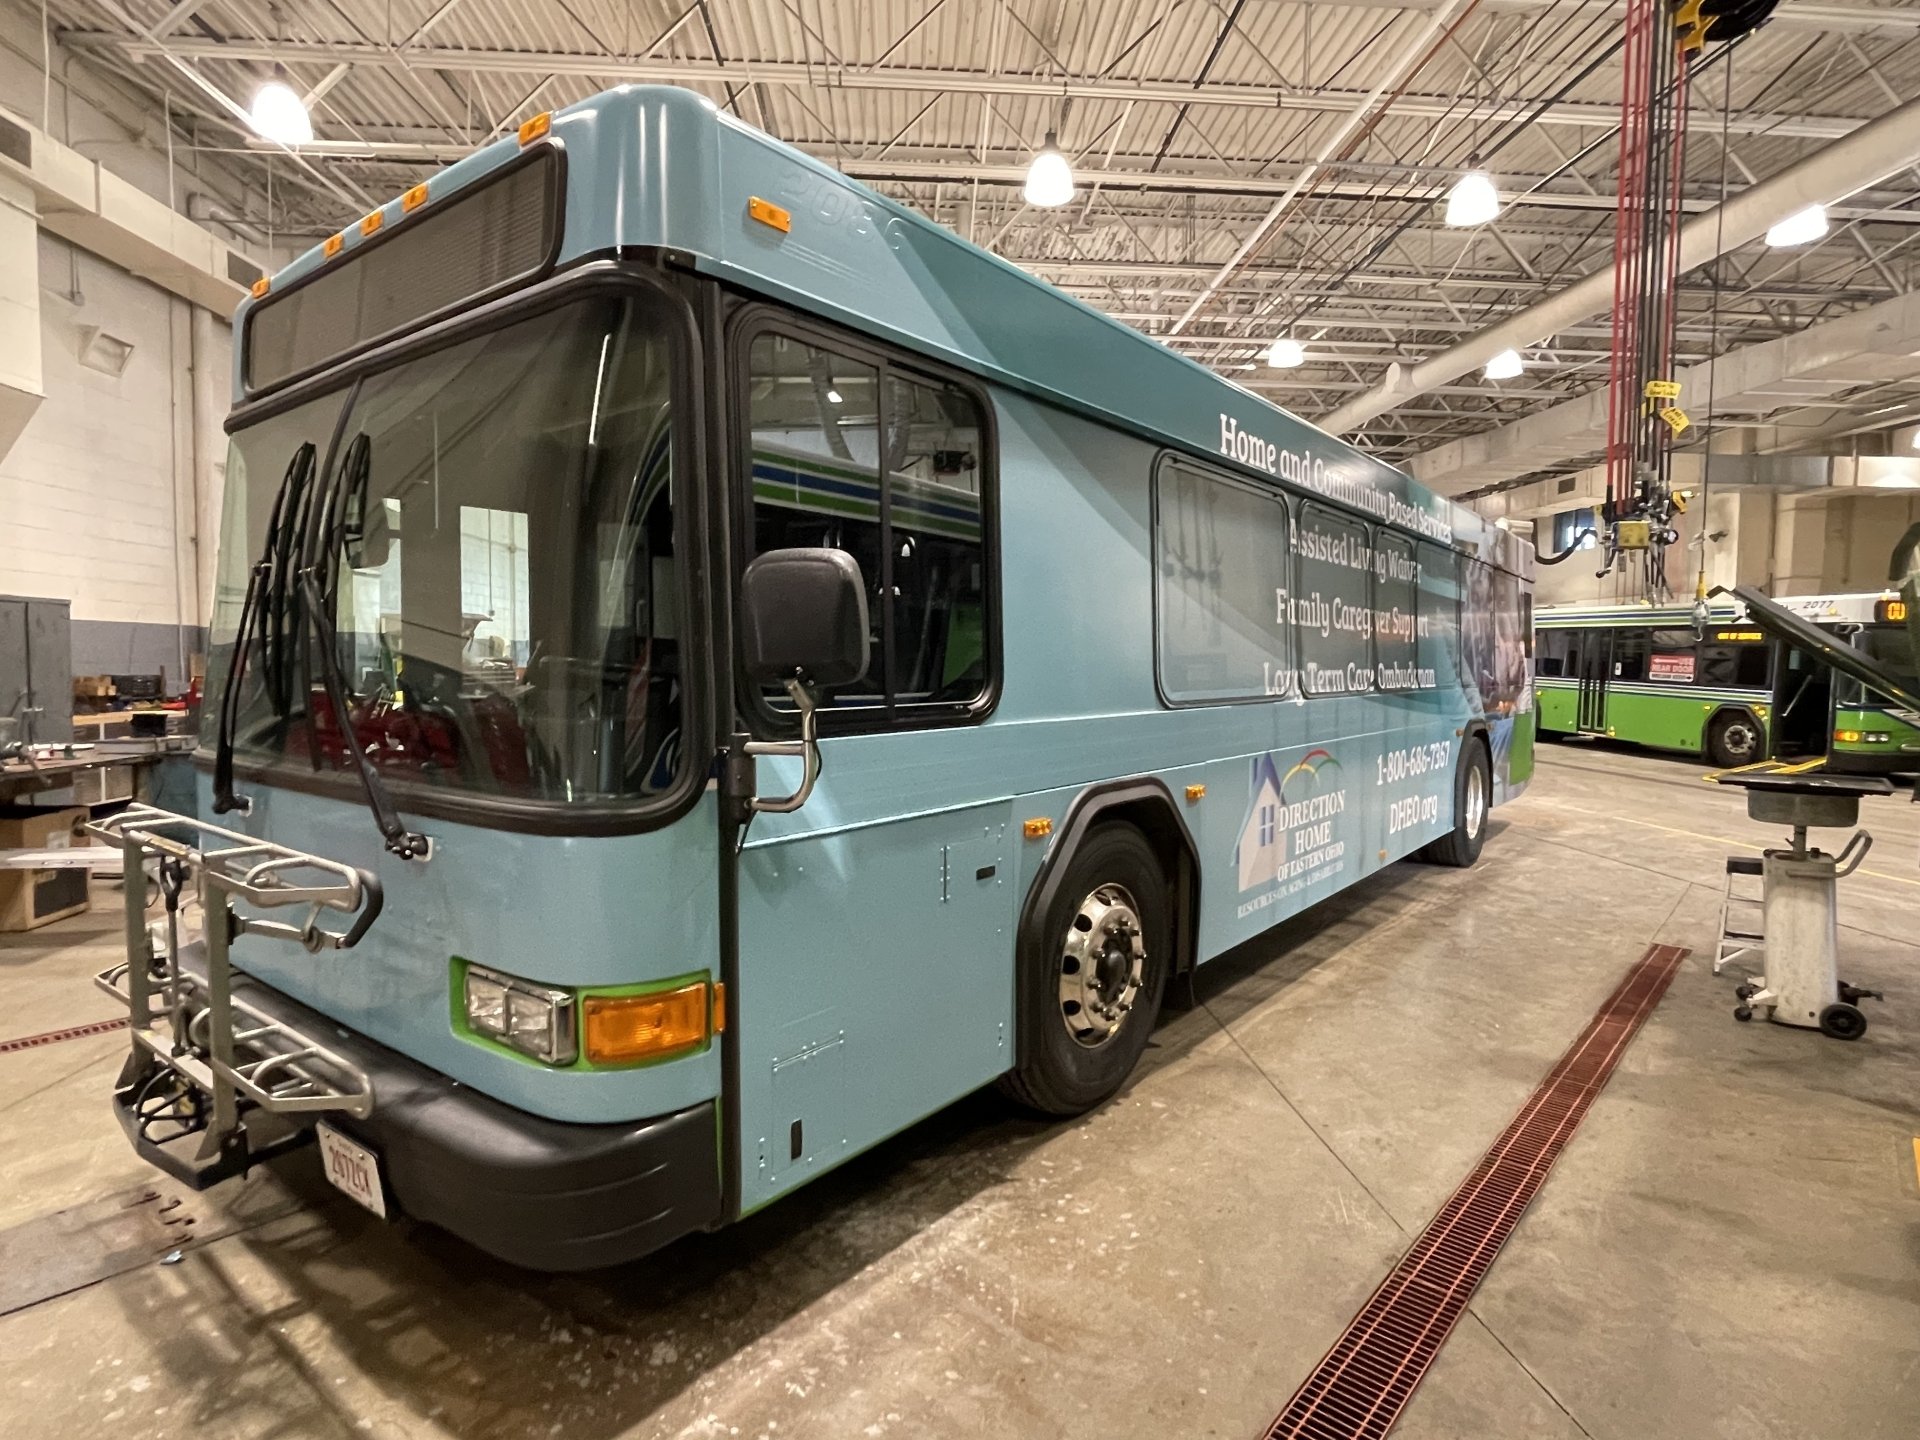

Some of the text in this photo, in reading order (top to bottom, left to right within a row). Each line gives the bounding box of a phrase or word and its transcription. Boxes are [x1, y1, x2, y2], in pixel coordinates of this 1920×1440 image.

[1220, 414, 1452, 544] Home and Community Based Services
[1289, 518, 1422, 584] Assisted Livng Waivr
[1276, 588, 1429, 643] Family Caregver Supprt
[1802, 600, 1834, 609] 2077
[1307, 662, 1346, 694] Term
[1347, 662, 1375, 692] Care
[1651, 664, 1694, 673] REAR DOOR
[1376, 740, 1450, 786] 1-800-686-7367
[1278, 790, 1346, 832] DIRECTION
[1295, 820, 1331, 855] HOME
[1277, 863, 1290, 882] OF
[1290, 847, 1324, 877] EASTERN
